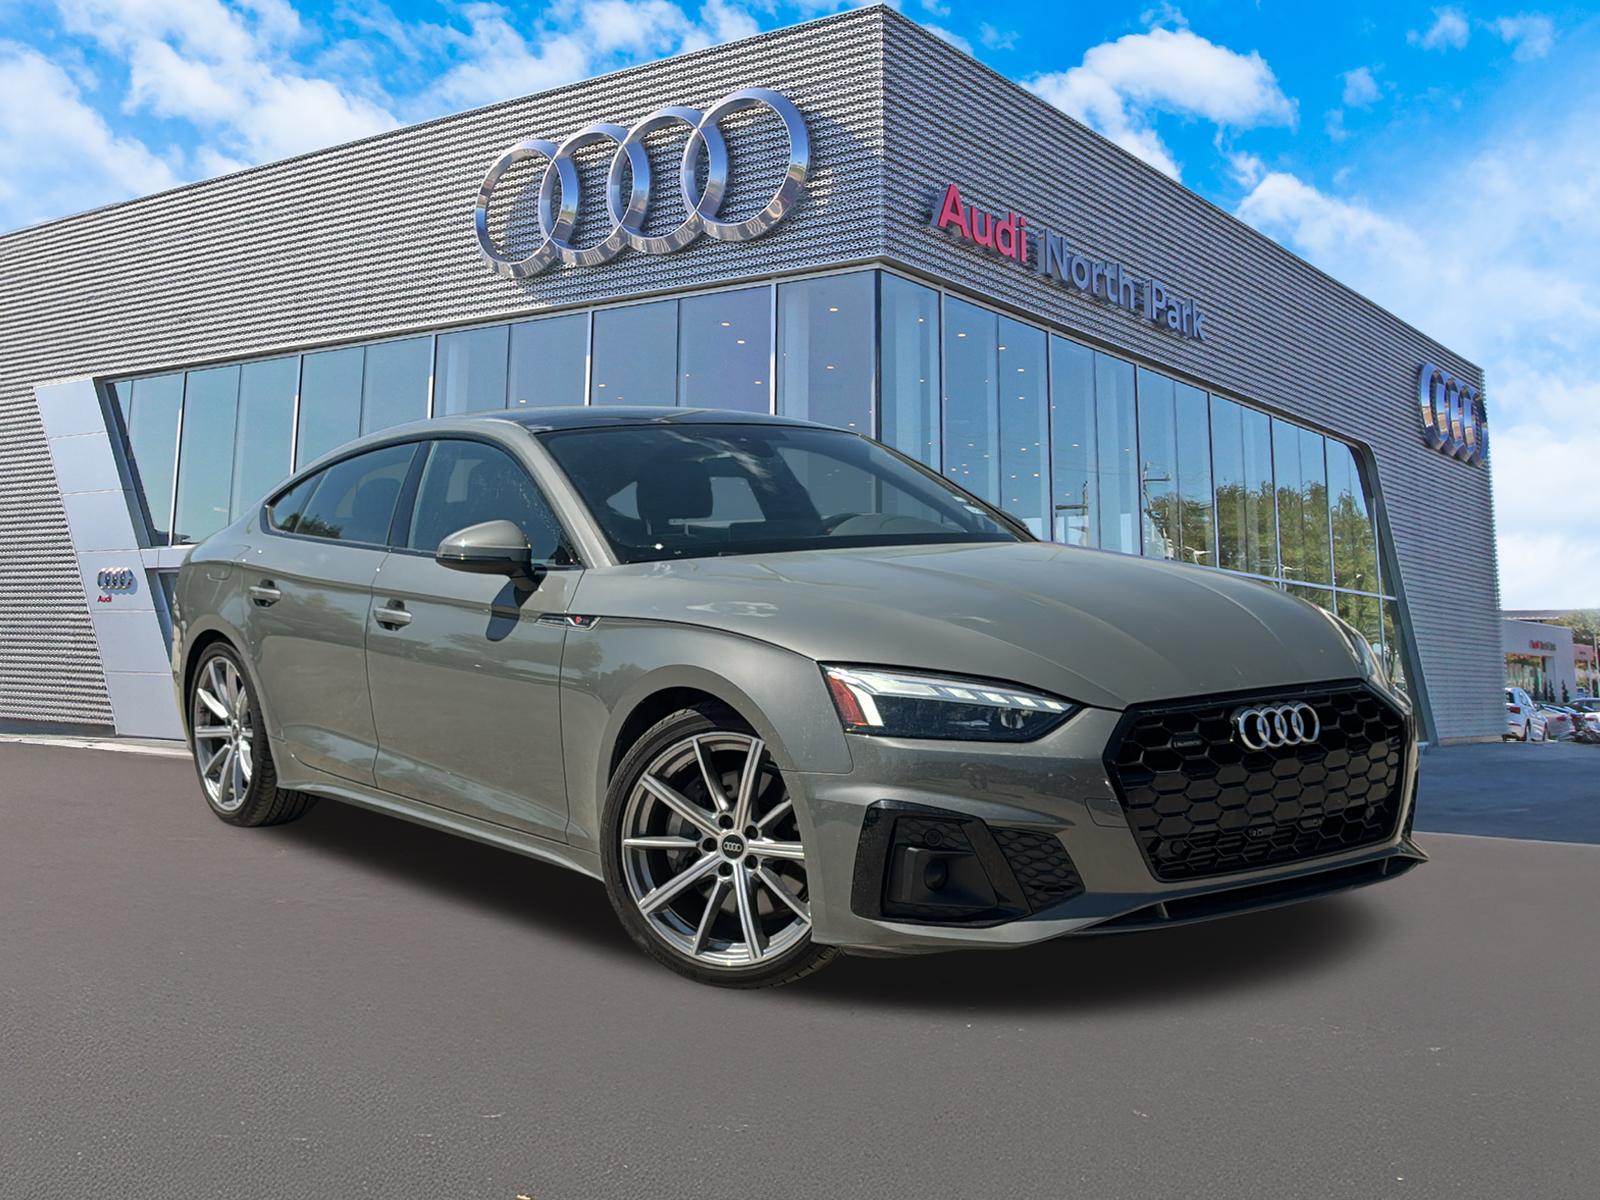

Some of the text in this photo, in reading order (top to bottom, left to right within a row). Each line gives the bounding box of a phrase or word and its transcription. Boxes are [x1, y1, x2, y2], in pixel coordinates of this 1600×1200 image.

[931, 183, 1206, 341] Audi North Park
